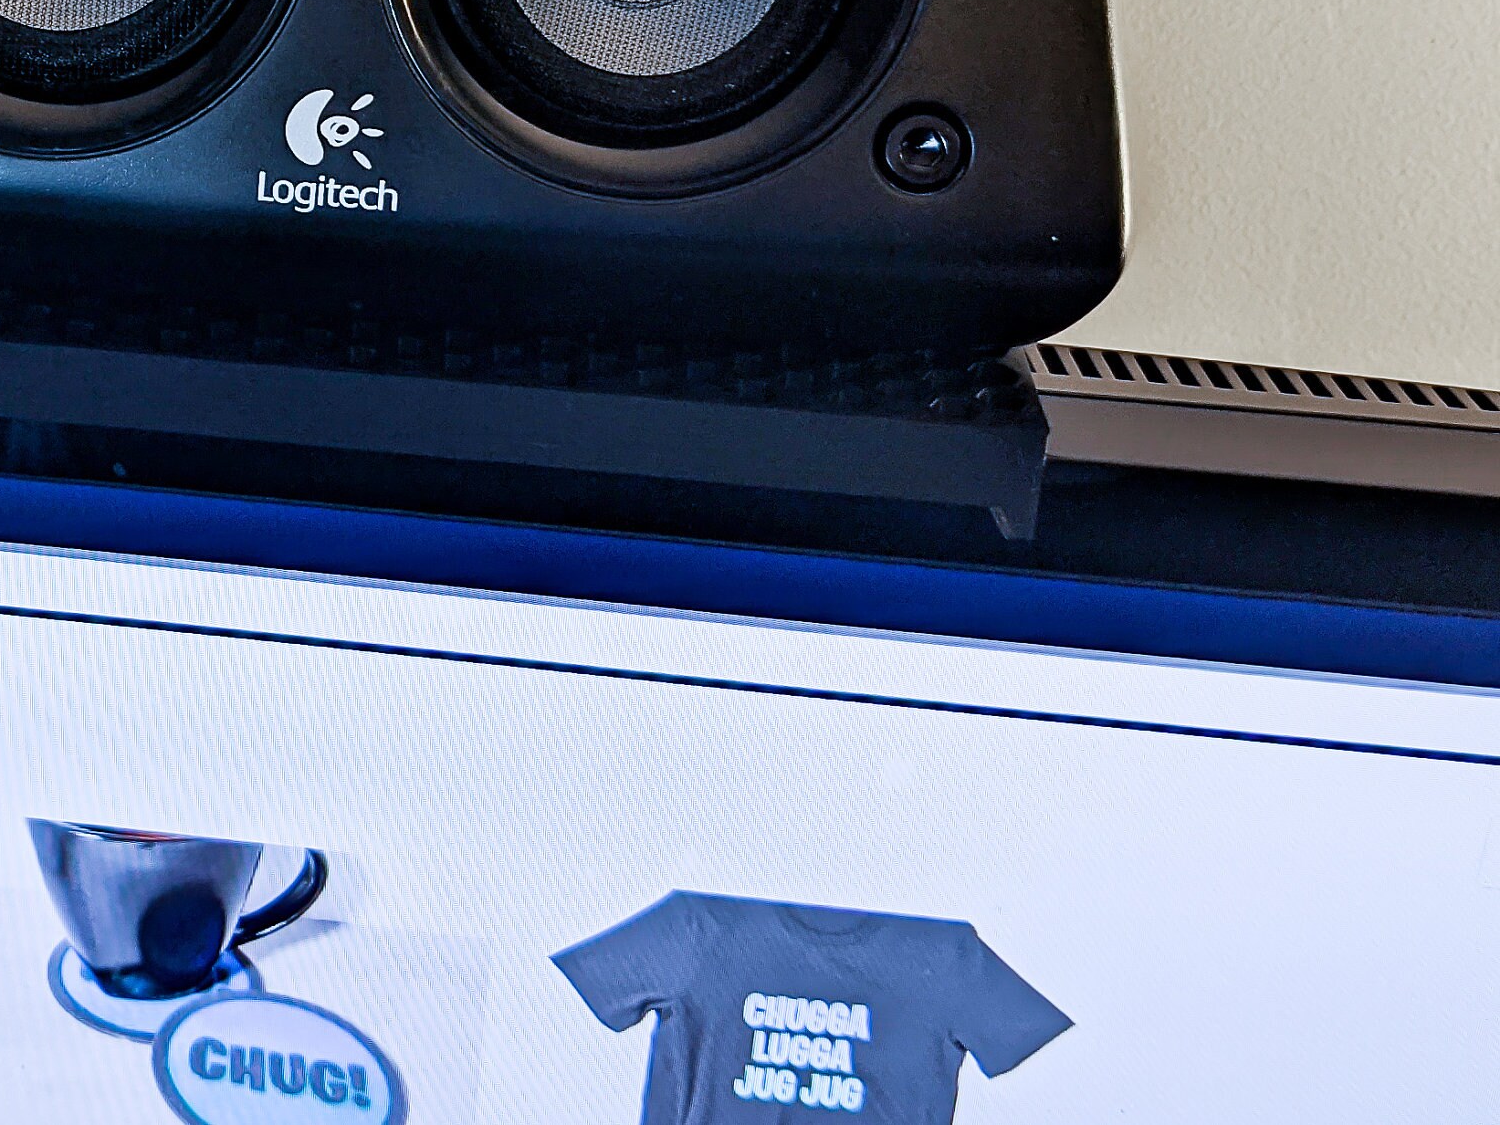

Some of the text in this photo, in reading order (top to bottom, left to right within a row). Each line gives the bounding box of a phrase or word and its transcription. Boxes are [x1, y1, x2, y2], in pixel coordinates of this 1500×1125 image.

[257, 171, 398, 213] Logitech
[743, 992, 871, 1041] CHUGGA
[188, 1037, 371, 1109] CHUG!
[752, 1030, 853, 1075] LUGGA
[733, 1064, 865, 1112] JUG JUG
